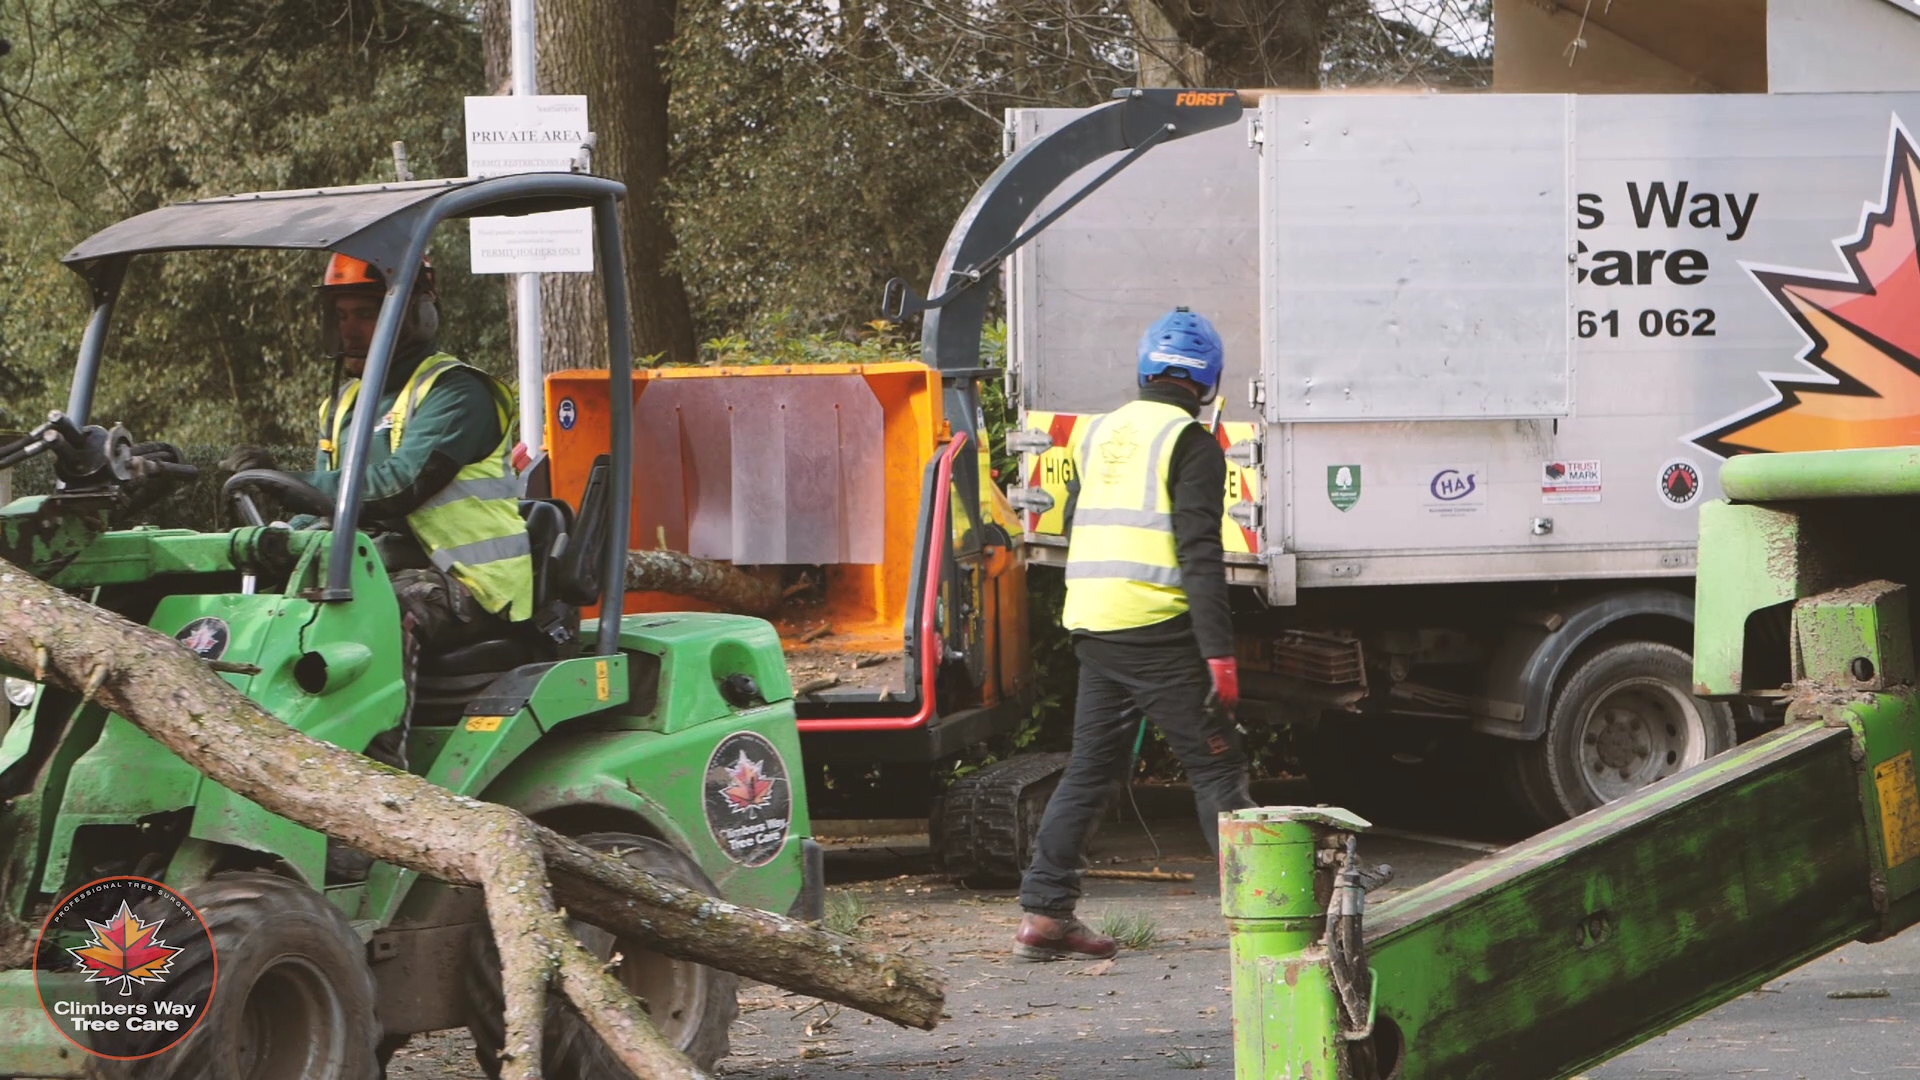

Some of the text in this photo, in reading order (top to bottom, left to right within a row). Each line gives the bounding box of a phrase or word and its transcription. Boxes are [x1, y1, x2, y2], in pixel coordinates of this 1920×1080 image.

[1175, 91, 1234, 106] FÖRST
[472, 130, 582, 142] PRIVATE AREA
[1626, 181, 1759, 241] Way
[1638, 309, 1716, 337] 062
[1568, 462, 1598, 471] TRUST
[1569, 470, 1598, 480] MARK
[1430, 469, 1475, 500] CHAS
